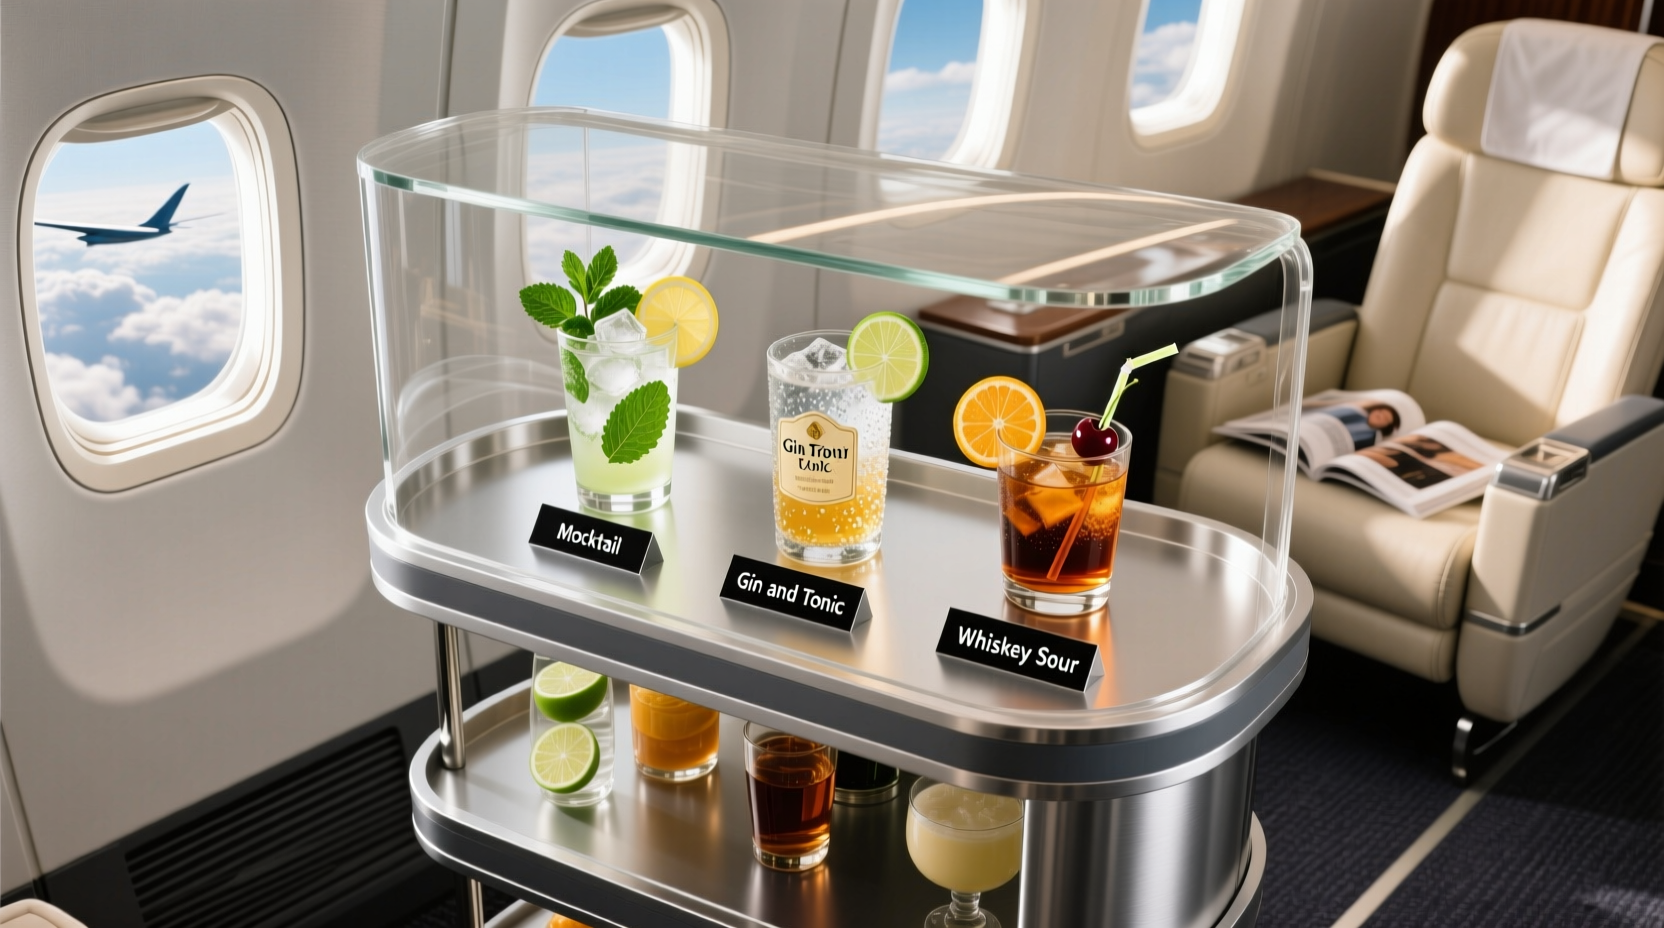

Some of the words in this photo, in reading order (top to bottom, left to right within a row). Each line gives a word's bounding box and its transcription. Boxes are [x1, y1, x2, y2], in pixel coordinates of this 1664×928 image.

[783, 438, 806, 456] Gin
[557, 522, 623, 555] Mocktail
[738, 571, 763, 594] Gin
[767, 583, 800, 603] and
[803, 587, 846, 615] Tonic
[958, 626, 1033, 666] Whiskey
[1036, 647, 1080, 674] Sour
